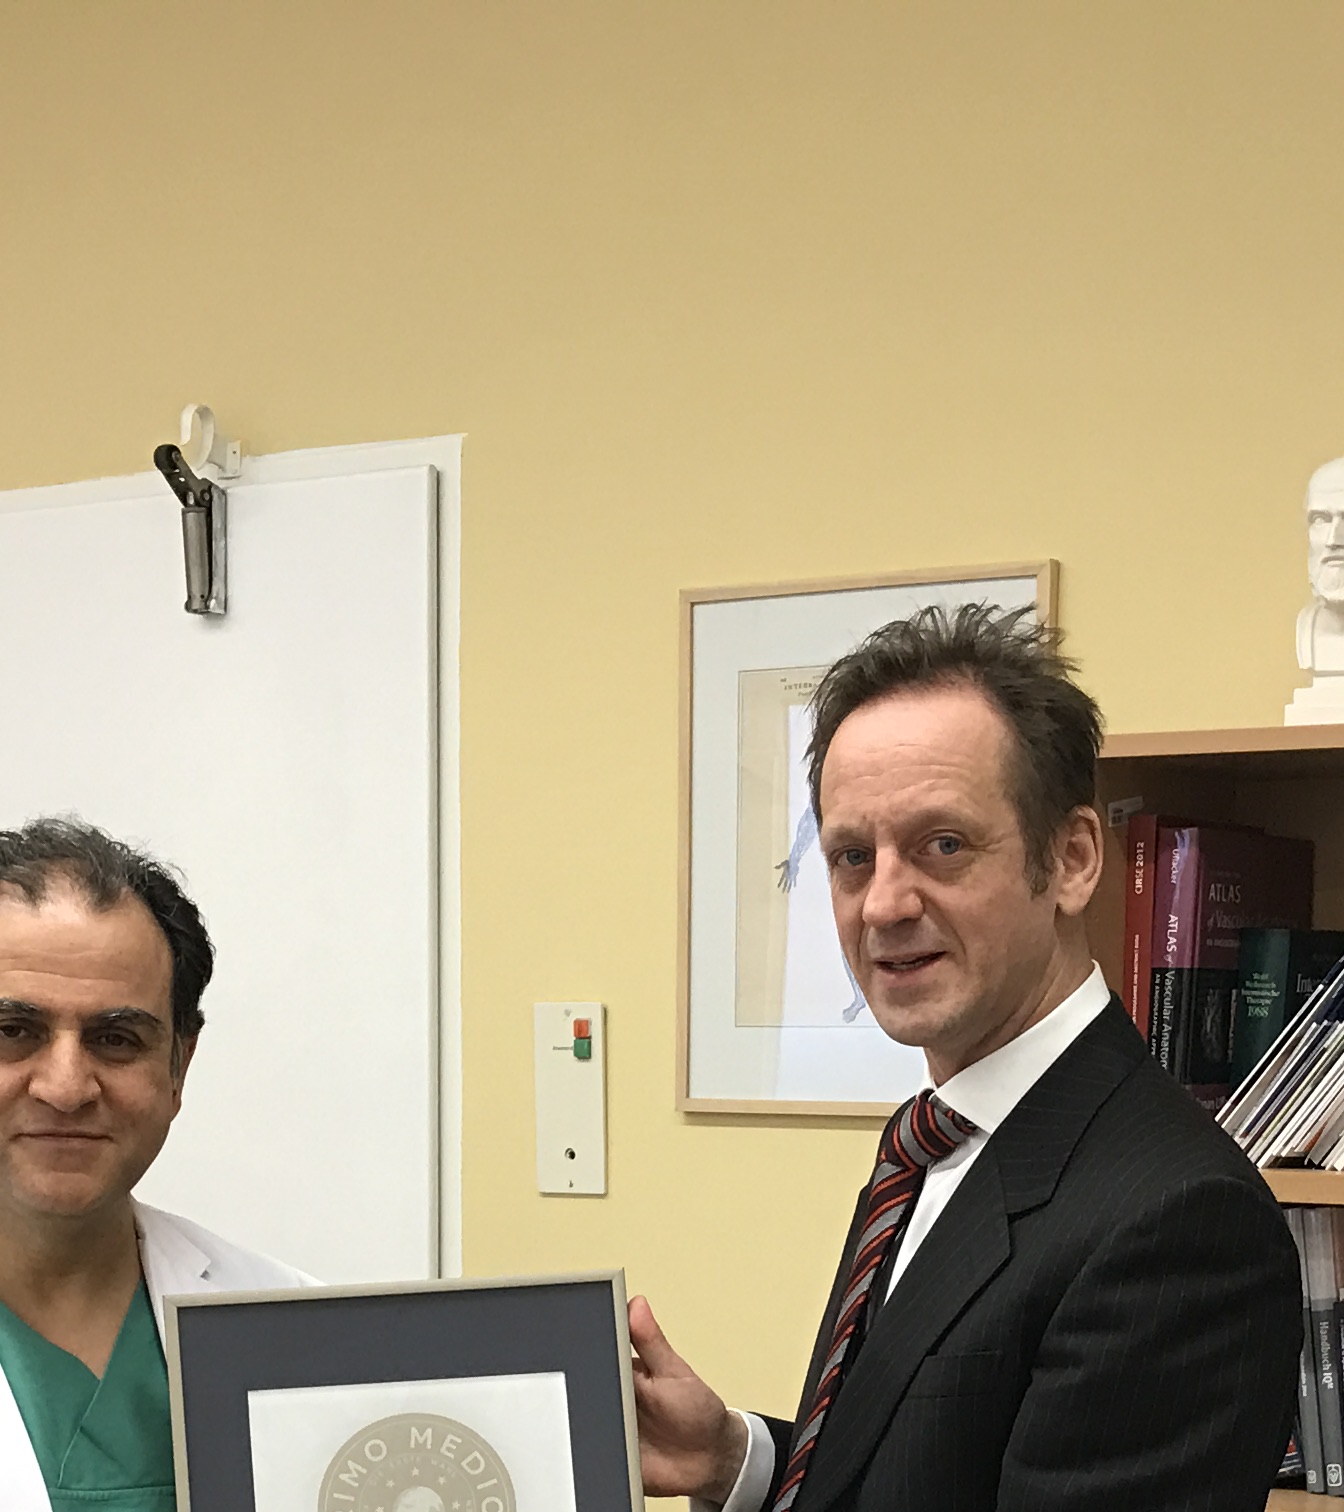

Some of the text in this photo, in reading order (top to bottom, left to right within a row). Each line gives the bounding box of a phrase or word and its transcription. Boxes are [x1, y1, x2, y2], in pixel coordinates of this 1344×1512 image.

[1134, 840, 1145, 894] CIRSE 2012
[1209, 884, 1241, 903] ATLAS
[1166, 914, 1179, 952] ATLAS
[1162, 970, 1176, 1022] Vascular
[1247, 1006, 1268, 1017] 1988
[1316, 1321, 1334, 1371] Handbuch
